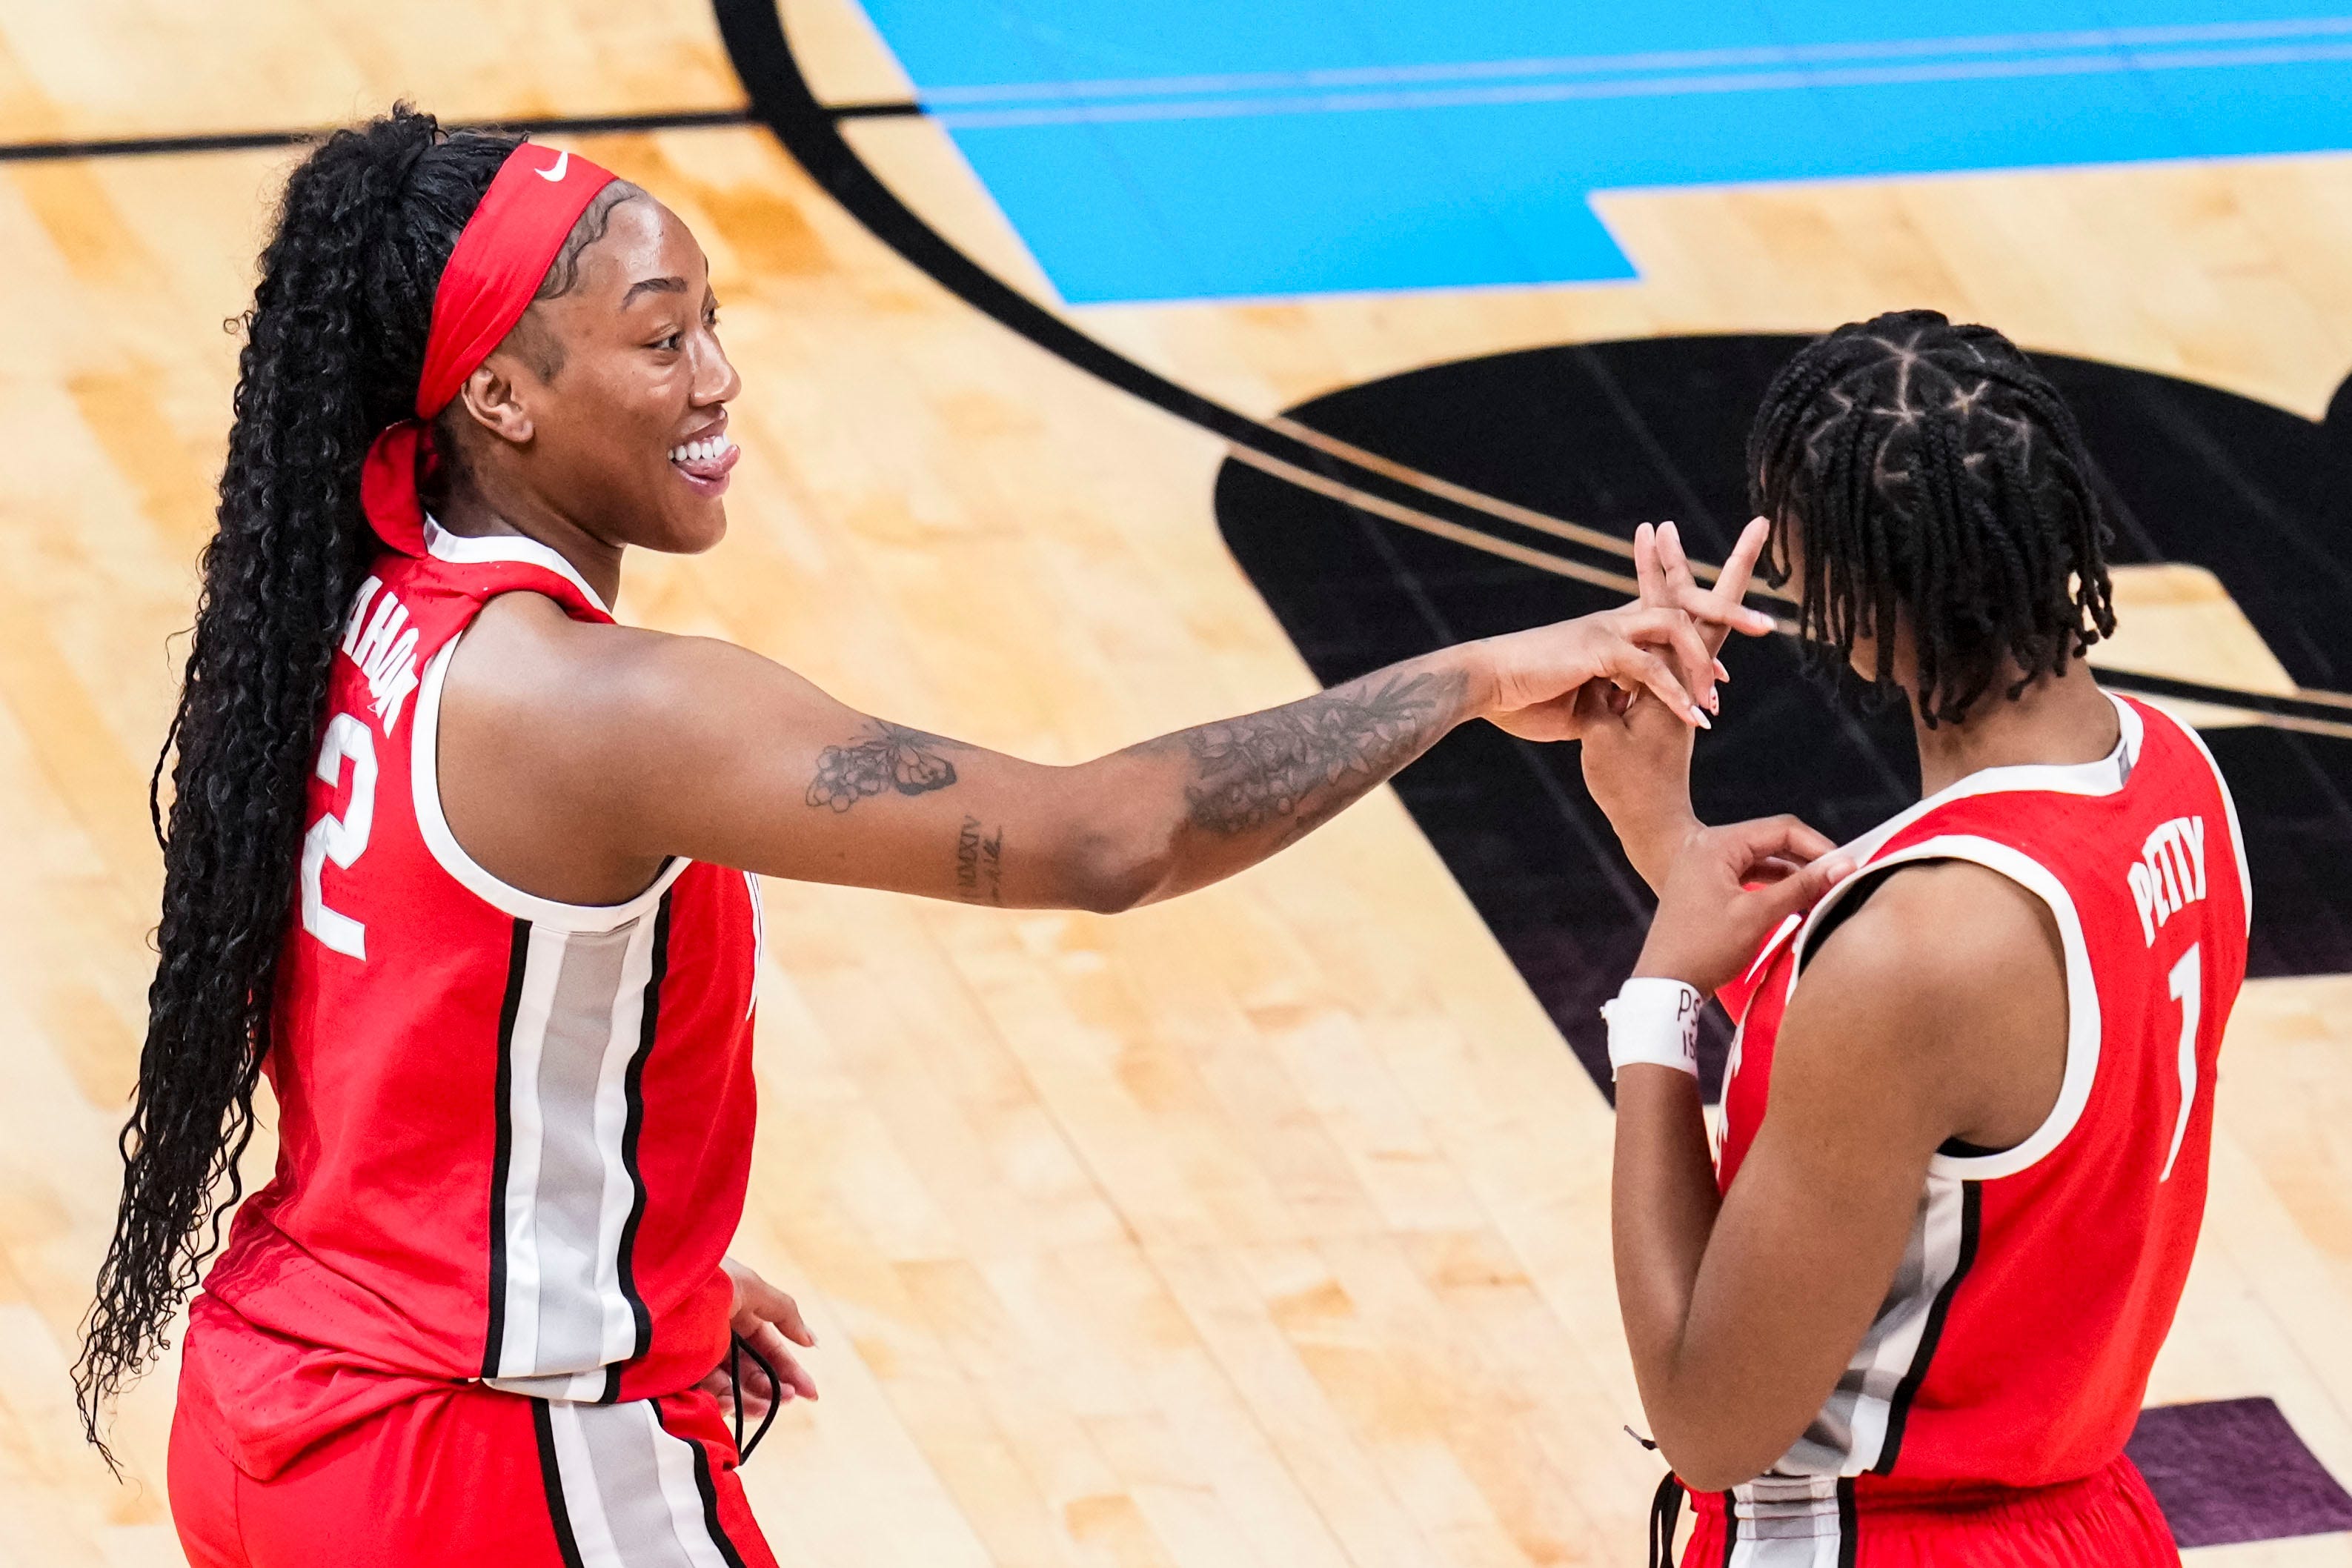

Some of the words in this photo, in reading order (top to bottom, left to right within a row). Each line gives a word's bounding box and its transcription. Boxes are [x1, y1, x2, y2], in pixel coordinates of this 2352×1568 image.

[301, 711, 379, 962] 2
[2127, 815, 2207, 949] PETTY
[2159, 941, 2202, 1183] 1
